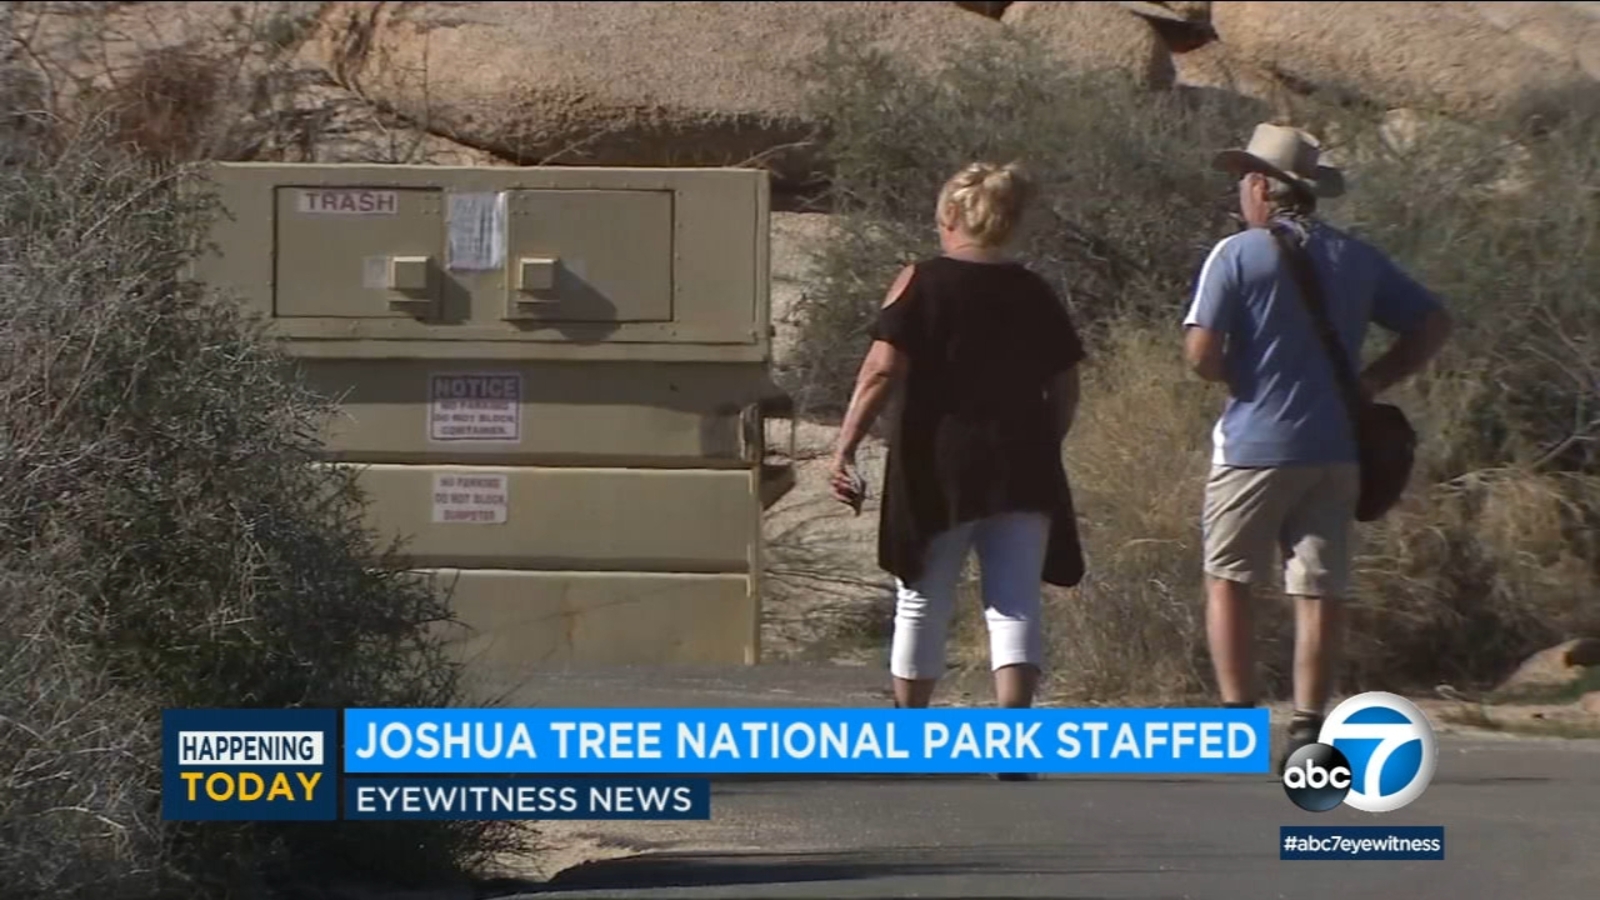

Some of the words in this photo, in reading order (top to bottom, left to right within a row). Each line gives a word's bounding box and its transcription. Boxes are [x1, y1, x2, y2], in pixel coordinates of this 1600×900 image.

[306, 193, 395, 212] TRASH
[434, 378, 517, 398] NOTICE
[452, 414, 475, 422] NOT
[479, 414, 514, 423] BLOCK
[451, 493, 471, 504] NOT
